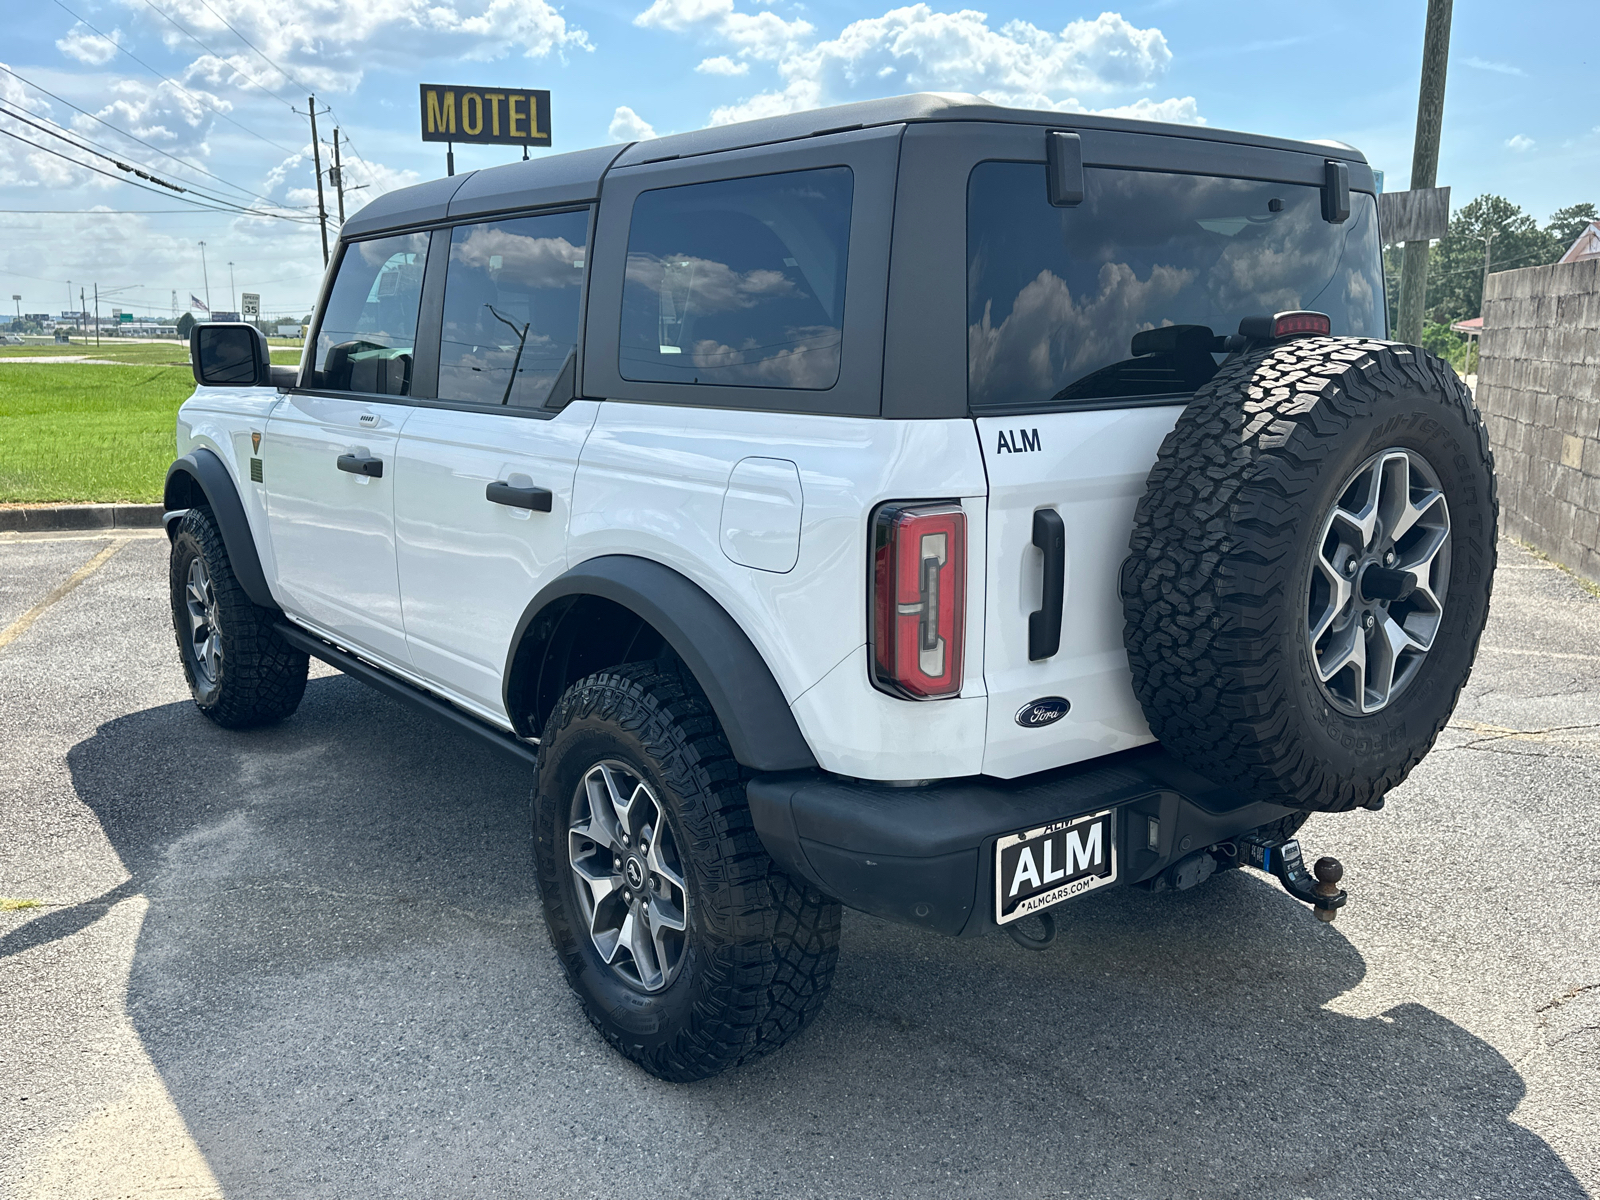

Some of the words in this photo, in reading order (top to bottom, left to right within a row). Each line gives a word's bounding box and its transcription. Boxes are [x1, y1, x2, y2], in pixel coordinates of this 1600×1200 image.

[426, 90, 548, 138] MOTEL
[244, 306, 257, 314] 35
[997, 428, 1042, 454] ALM
[1030, 705, 1060, 723] Ford
[1008, 821, 1102, 897] ALM
[538, 794, 588, 978] WRANGLER
[1026, 880, 1090, 912] ALMCARS.COM
